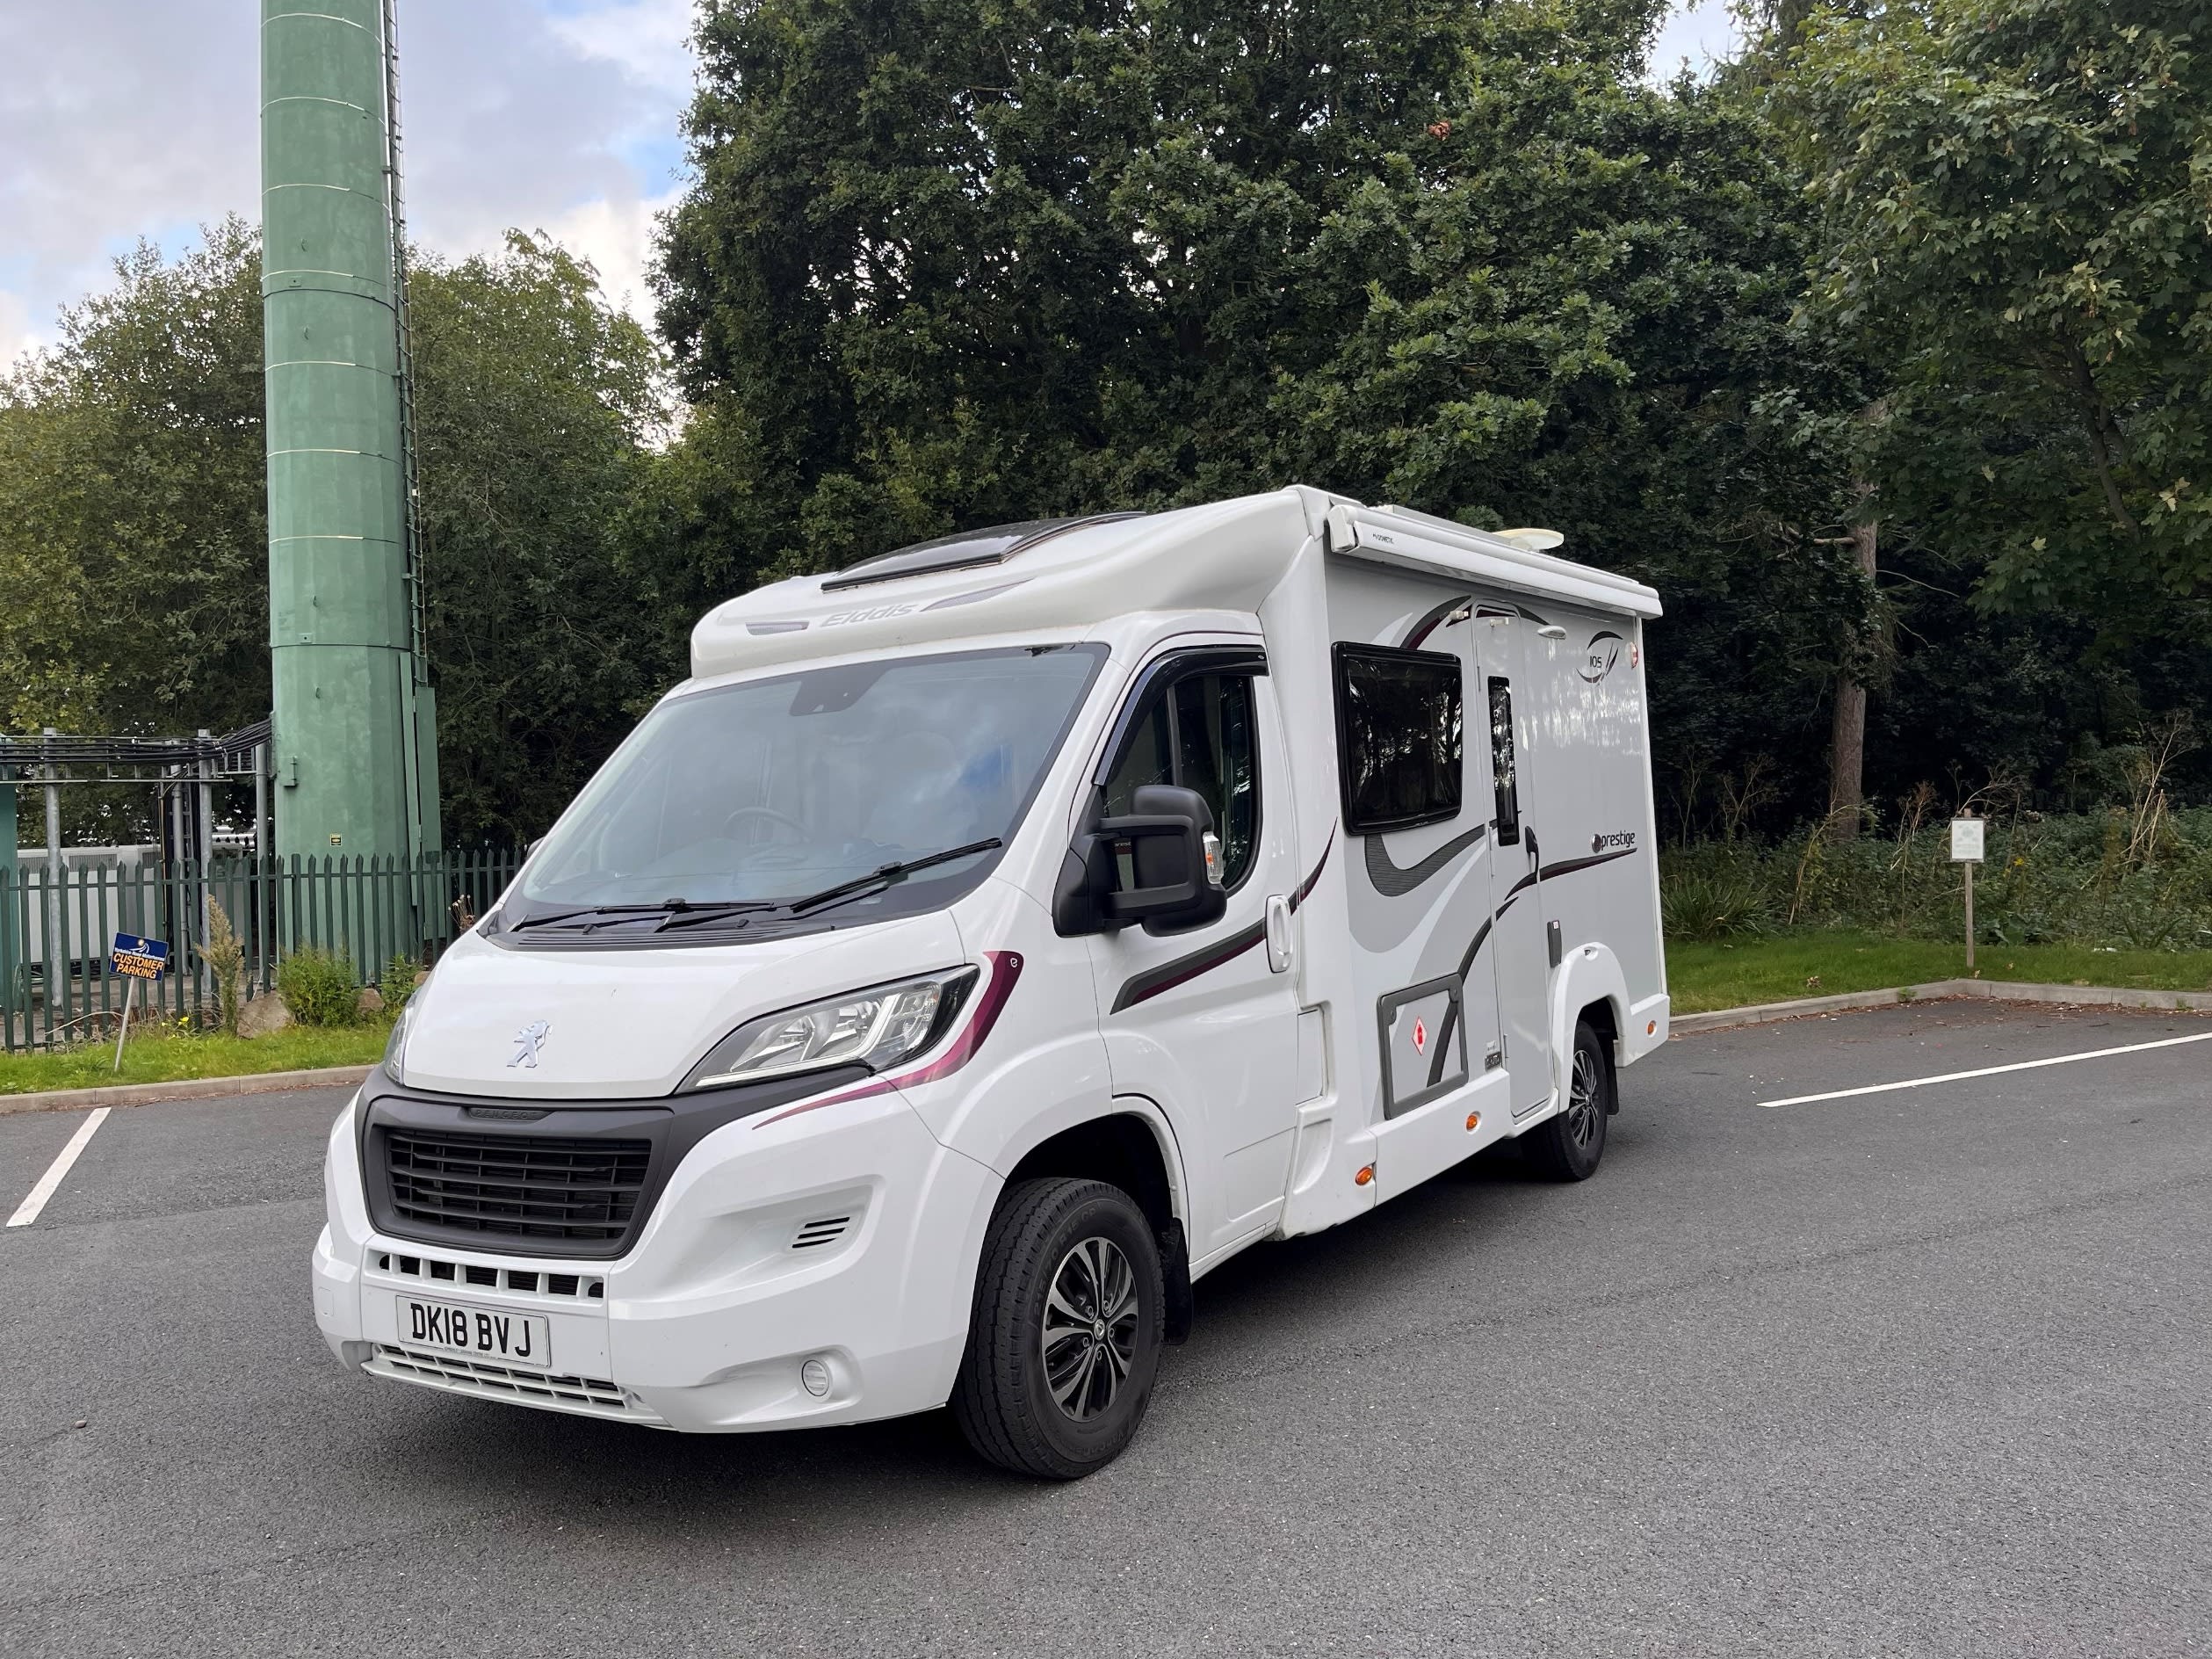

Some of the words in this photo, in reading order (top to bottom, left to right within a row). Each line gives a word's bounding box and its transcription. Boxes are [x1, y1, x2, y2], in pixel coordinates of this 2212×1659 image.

[819, 604, 919, 627] Elddis
[1601, 830, 1636, 851] prestige
[113, 953, 164, 971] CUSTOMER
[116, 963, 157, 979] PARKING
[475, 1109, 538, 1119] PEUGEOT
[410, 1302, 468, 1347] DK18
[475, 1313, 531, 1357] BVJ
